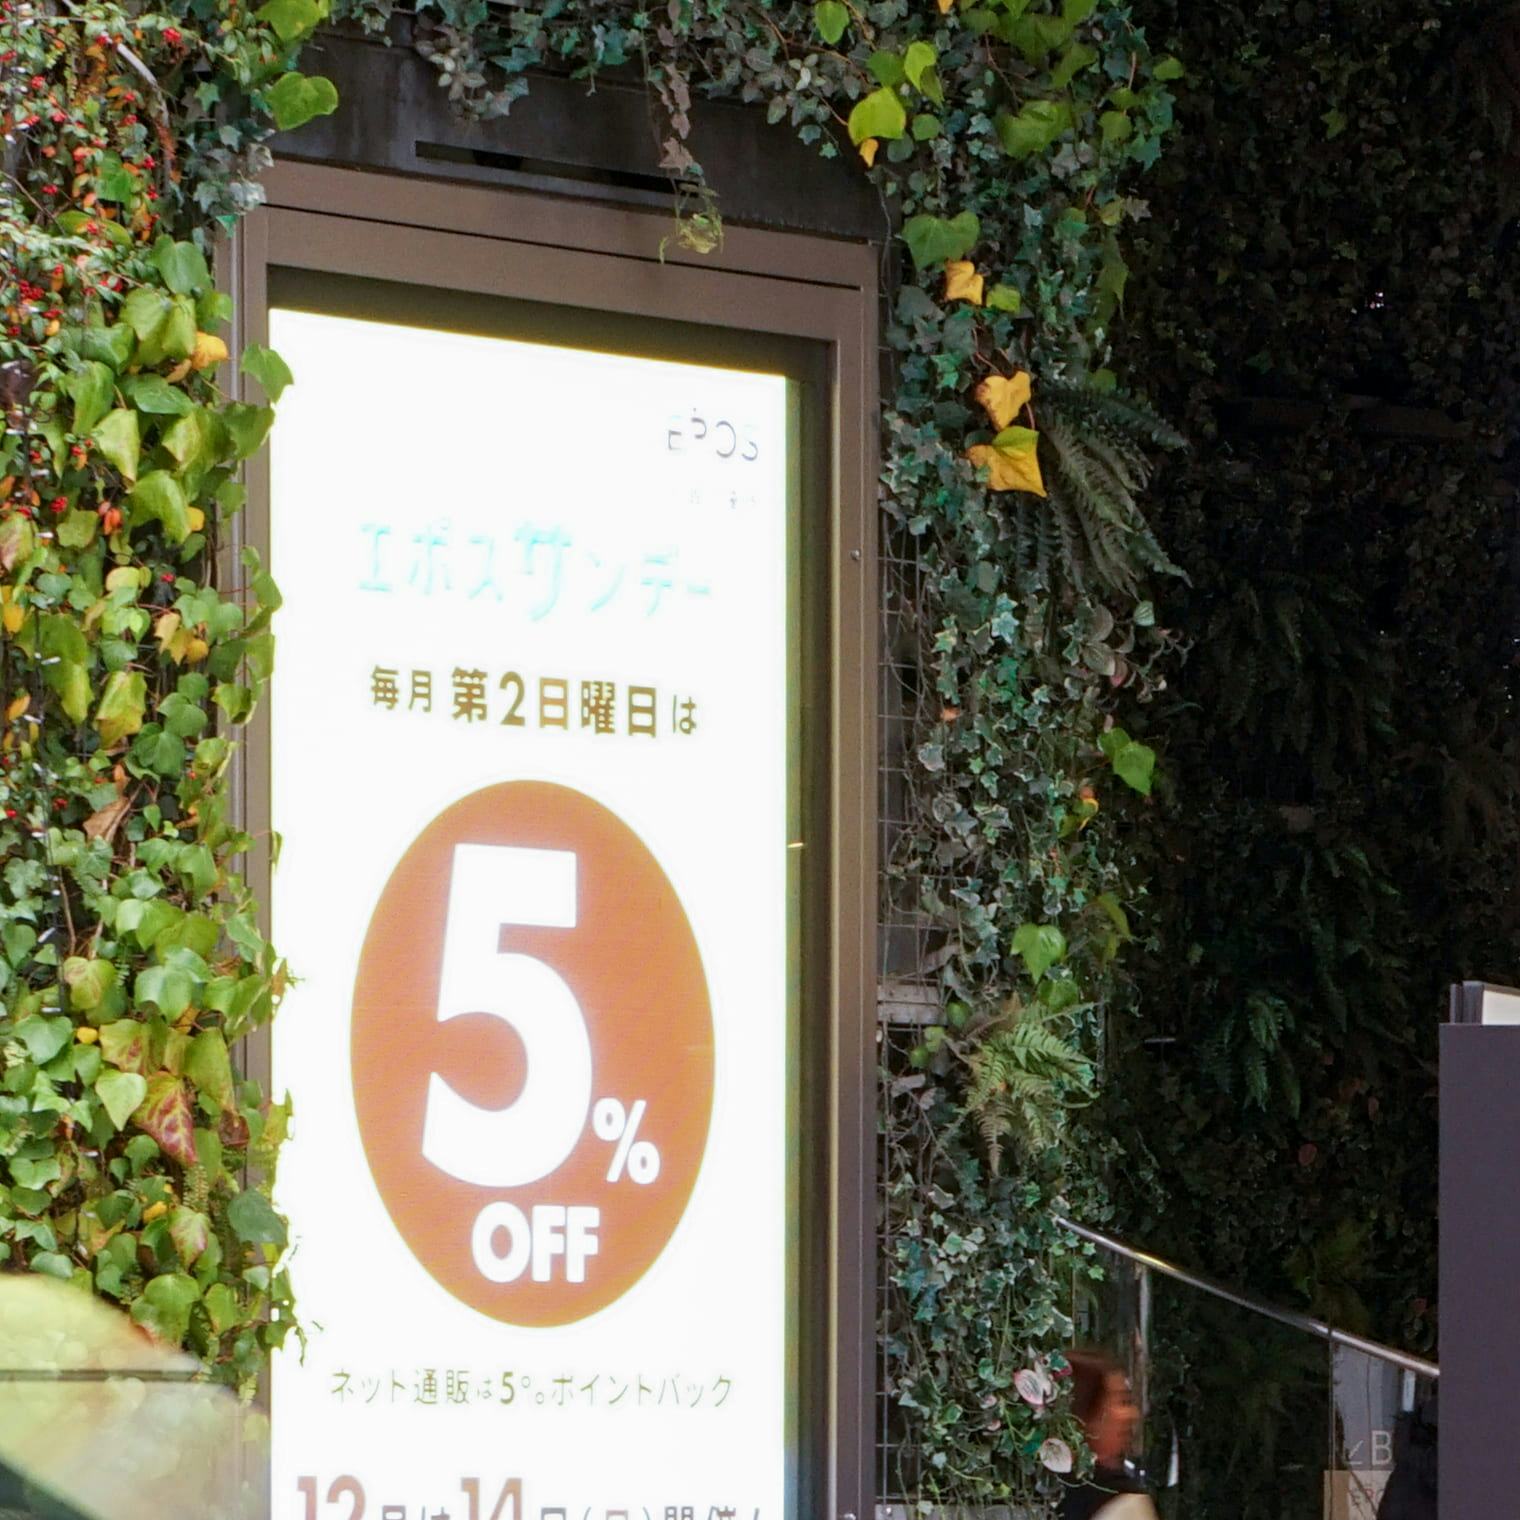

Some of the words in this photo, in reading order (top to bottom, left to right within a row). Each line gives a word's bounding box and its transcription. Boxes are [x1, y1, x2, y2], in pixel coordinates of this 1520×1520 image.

[356, 518, 714, 622] エポスサンデー
[471, 1201, 600, 1284] OFF
